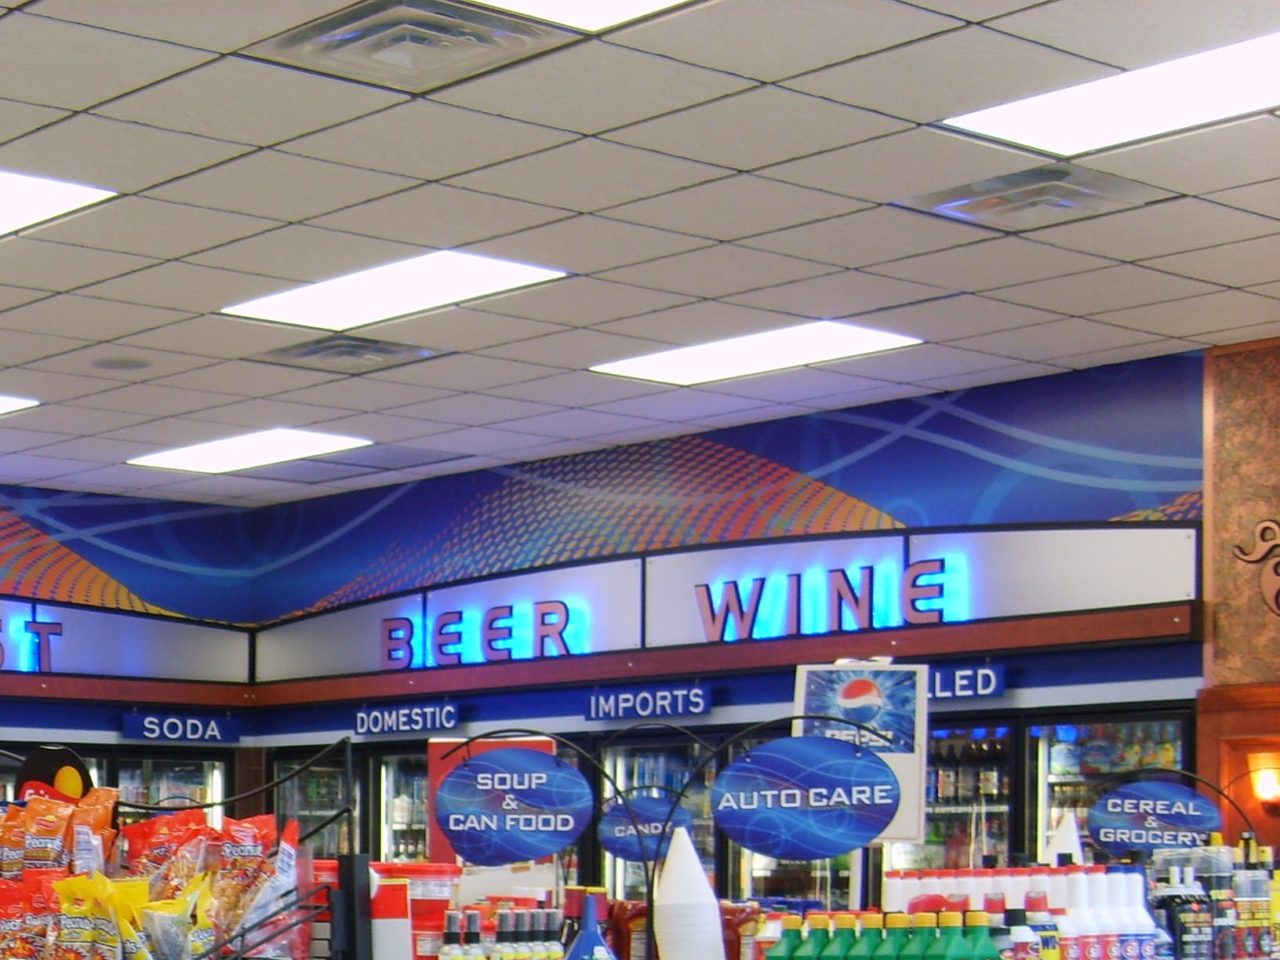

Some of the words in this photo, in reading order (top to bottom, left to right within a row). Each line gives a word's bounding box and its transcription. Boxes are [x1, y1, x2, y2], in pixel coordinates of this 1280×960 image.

[695, 558, 946, 643] WINE
[381, 602, 570, 669] BEER
[926, 669, 997, 699] LED
[590, 688, 705, 718] IMPORTS
[142, 717, 222, 741] SODA
[356, 705, 455, 735] DOMESTIC
[477, 773, 548, 790] SOUP
[502, 794, 518, 810] &
[717, 790, 802, 810] AUTO
[808, 784, 893, 807] CARE
[1107, 799, 1202, 816] CEREAL
[448, 815, 499, 831] CAN
[505, 815, 575, 831] FOOD
[1144, 816, 1158, 828] &
[1099, 828, 1202, 845] GROCERY
